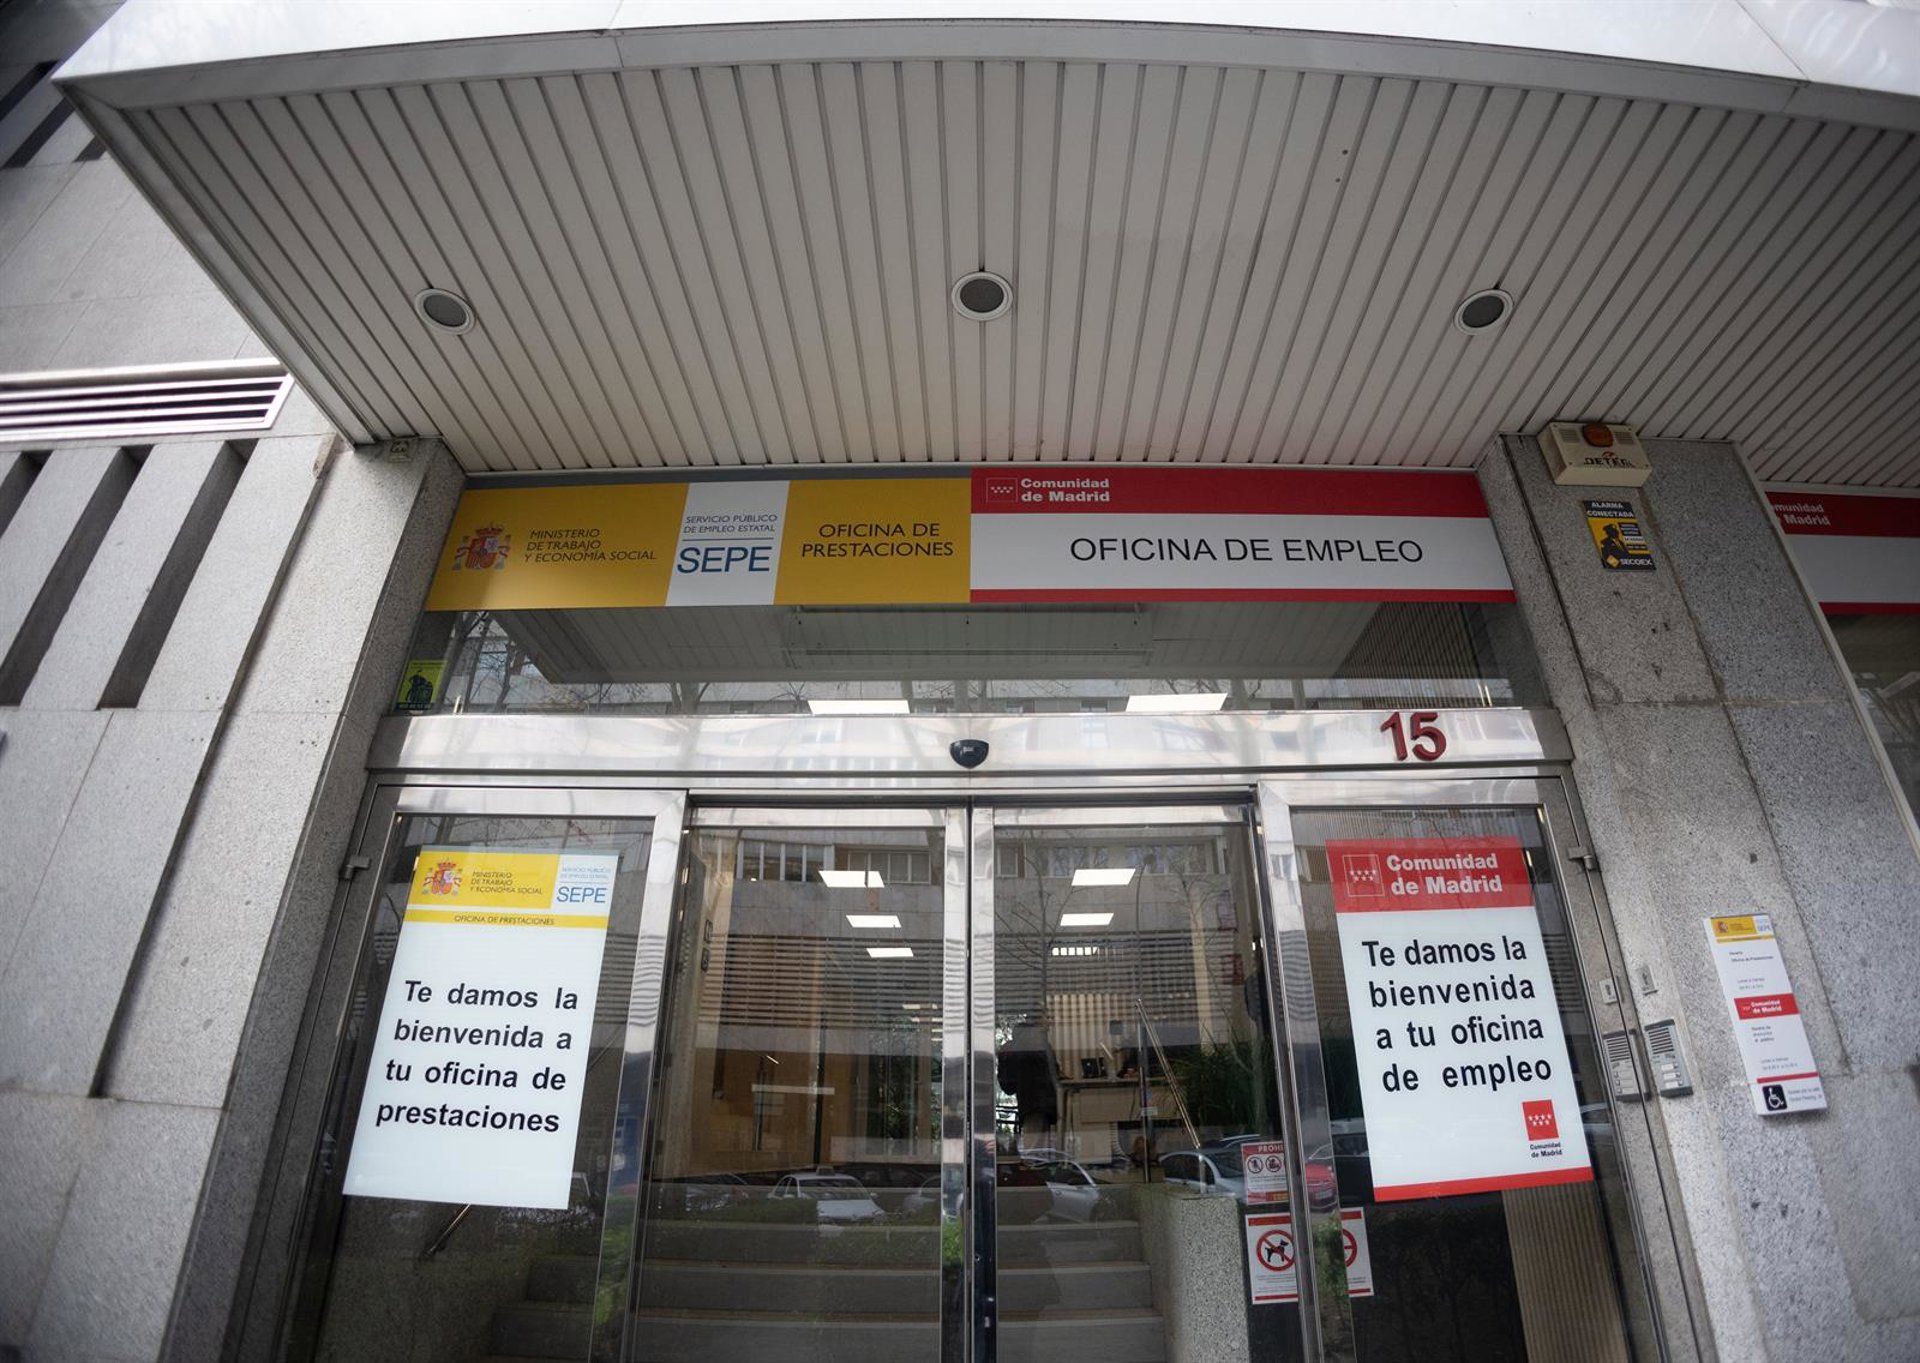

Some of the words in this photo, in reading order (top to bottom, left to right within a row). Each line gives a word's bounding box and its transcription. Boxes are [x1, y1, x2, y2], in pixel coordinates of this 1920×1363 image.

[1020, 477, 1110, 490] Comunidad
[1021, 490, 1043, 502] de
[1048, 490, 1110, 502] Madrid
[1586, 510, 1635, 518] CONECTADA
[1774, 503, 1825, 513] munidad
[686, 515, 731, 524] SERVICIO
[732, 513, 778, 523] PÚBLICO
[529, 528, 601, 540] MINISTERIO
[683, 526, 698, 534] DE
[699, 525, 735, 533] EMPLEO
[737, 524, 776, 533] ESTATAL
[819, 523, 905, 538] OFICINA
[912, 523, 940, 537] DE
[527, 541, 544, 551] DE
[544, 540, 601, 551] TRABAJO
[801, 541, 954, 558] PRESTACIONES
[1070, 538, 1217, 561] OFICINA
[1225, 539, 1273, 561] DE
[1283, 539, 1423, 563] EMPLEO
[524, 553, 533, 563] Y
[535, 550, 606, 563] ECONOMÍA
[609, 550, 657, 561] SOCIAL
[677, 546, 772, 574] SEPE
[1380, 711, 1447, 761] 15
[1386, 853, 1498, 872] Comunidad
[472, 871, 513, 879] MINISTERIO
[482, 878, 513, 886] TRABAJO
[517, 887, 543, 895] SOCIAL
[1390, 877, 1419, 896] de
[1425, 875, 1503, 895] Madrid
[556, 886, 608, 903] SEPE
[499, 917, 555, 925] PRESTACIONES
[1361, 940, 1395, 967] Te
[1404, 939, 1495, 965] damos
[1502, 936, 1527, 961] la
[405, 980, 432, 1003] Te
[447, 983, 539, 1008] damos
[554, 987, 578, 1010] la
[1368, 974, 1535, 1008] bienvenida
[394, 1018, 543, 1049] bienvenida
[556, 1032, 572, 1050] a
[1376, 1027, 1393, 1049] a
[1406, 1021, 1435, 1048] tu
[1451, 1014, 1544, 1045] oficina
[385, 1059, 411, 1082] tu
[424, 1061, 518, 1088] oficina
[532, 1067, 566, 1090] de
[1382, 1063, 1419, 1092] de
[1442, 1055, 1551, 1091] empleo
[375, 1103, 560, 1133] prestaciones
[1530, 1142, 1561, 1150] Comunidad
